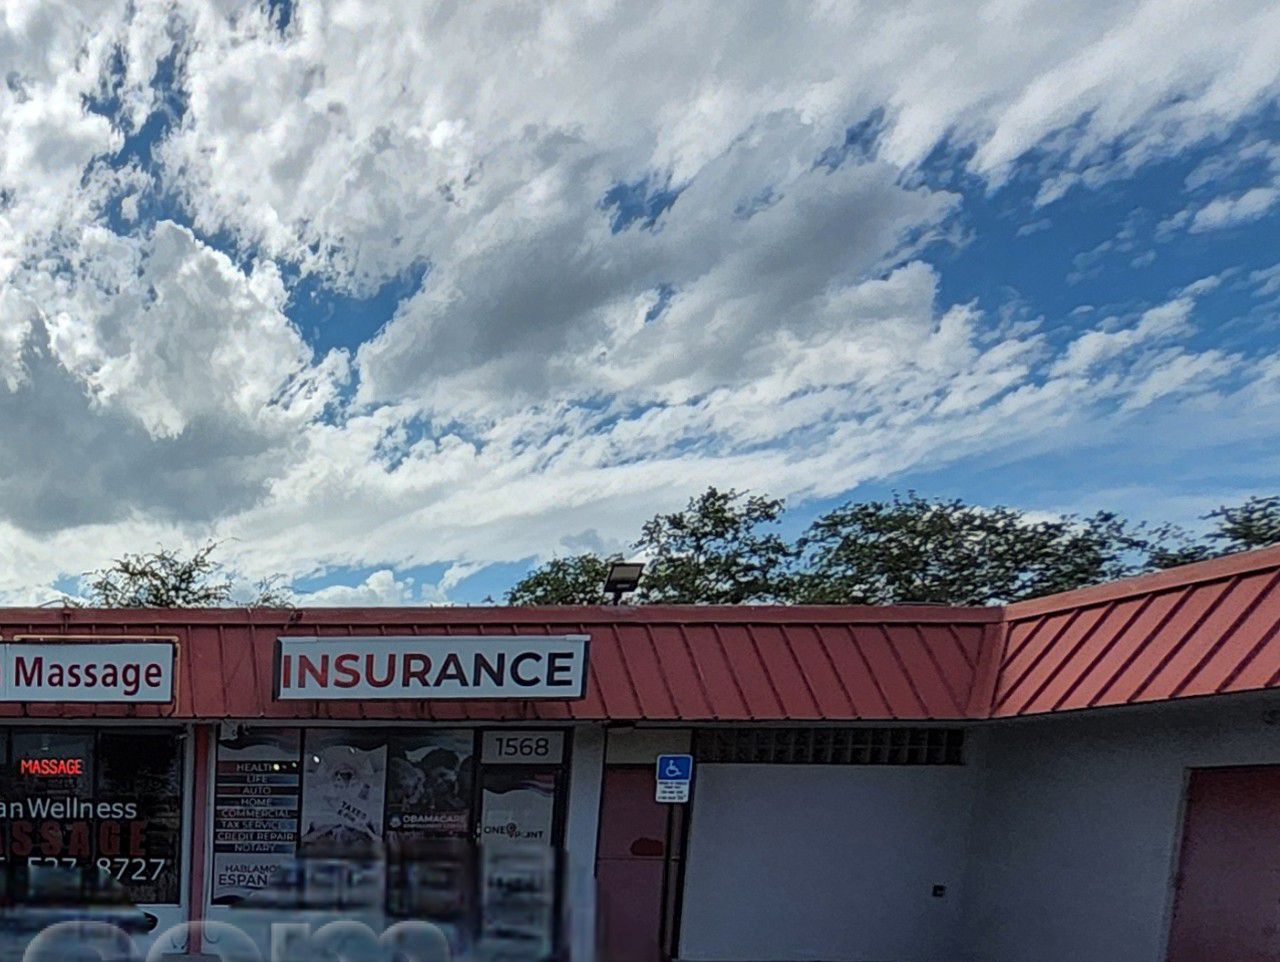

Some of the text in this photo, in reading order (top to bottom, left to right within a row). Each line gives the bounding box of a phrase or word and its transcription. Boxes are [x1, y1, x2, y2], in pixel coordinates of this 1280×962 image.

[282, 653, 574, 688] INSURANCE
[14, 656, 163, 696] Massage
[495, 737, 549, 756] 1568
[21, 759, 83, 775] MASSAGE
[246, 774, 268, 783] LIFE
[242, 787, 271, 795] AUTO
[240, 798, 272, 807] HOME
[27, 798, 138, 819] Wellness
[221, 809, 291, 818] COMMERCIAL
[221, 821, 239, 829] TAX
[484, 826, 505, 834] ONE
[217, 833, 294, 842] CREDIT REPAIR
[234, 844, 276, 852] NOTARY
[225, 865, 282, 875] HABLAMO
